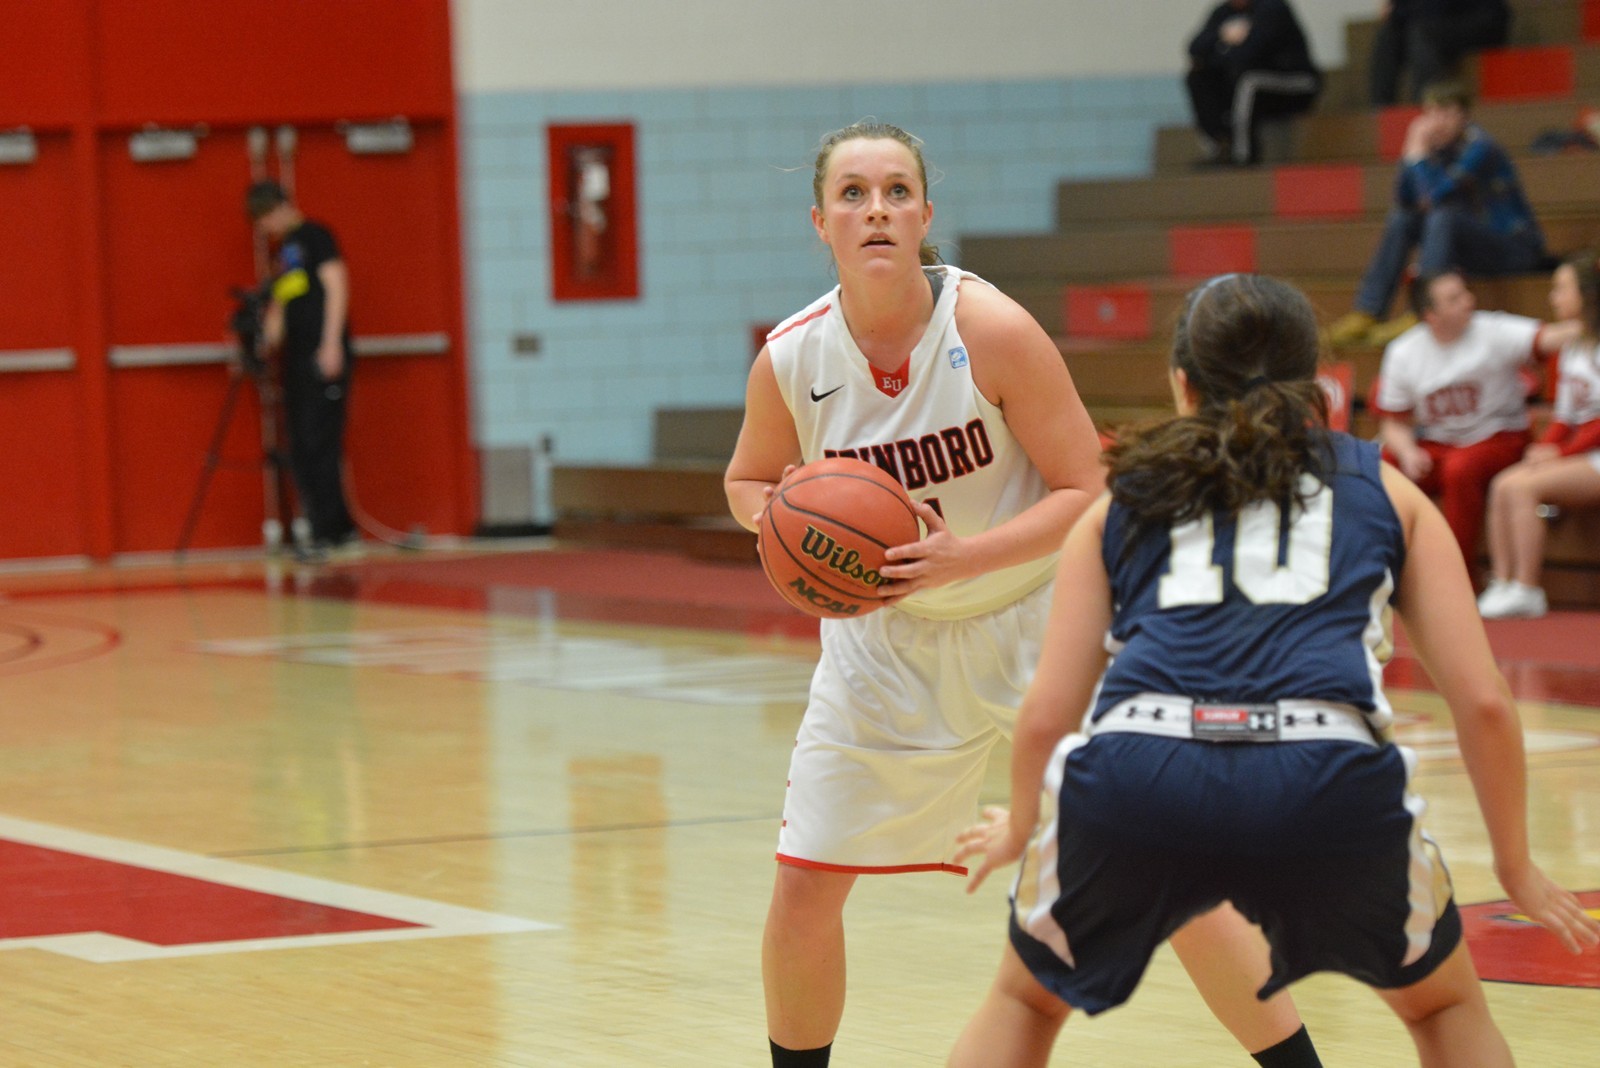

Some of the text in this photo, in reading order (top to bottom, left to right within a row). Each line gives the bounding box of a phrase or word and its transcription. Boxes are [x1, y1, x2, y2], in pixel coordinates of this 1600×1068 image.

[882, 377, 902, 391] EU
[824, 417, 994, 490] NBORO
[1157, 472, 1333, 609] 10
[789, 576, 861, 615] NCAA
